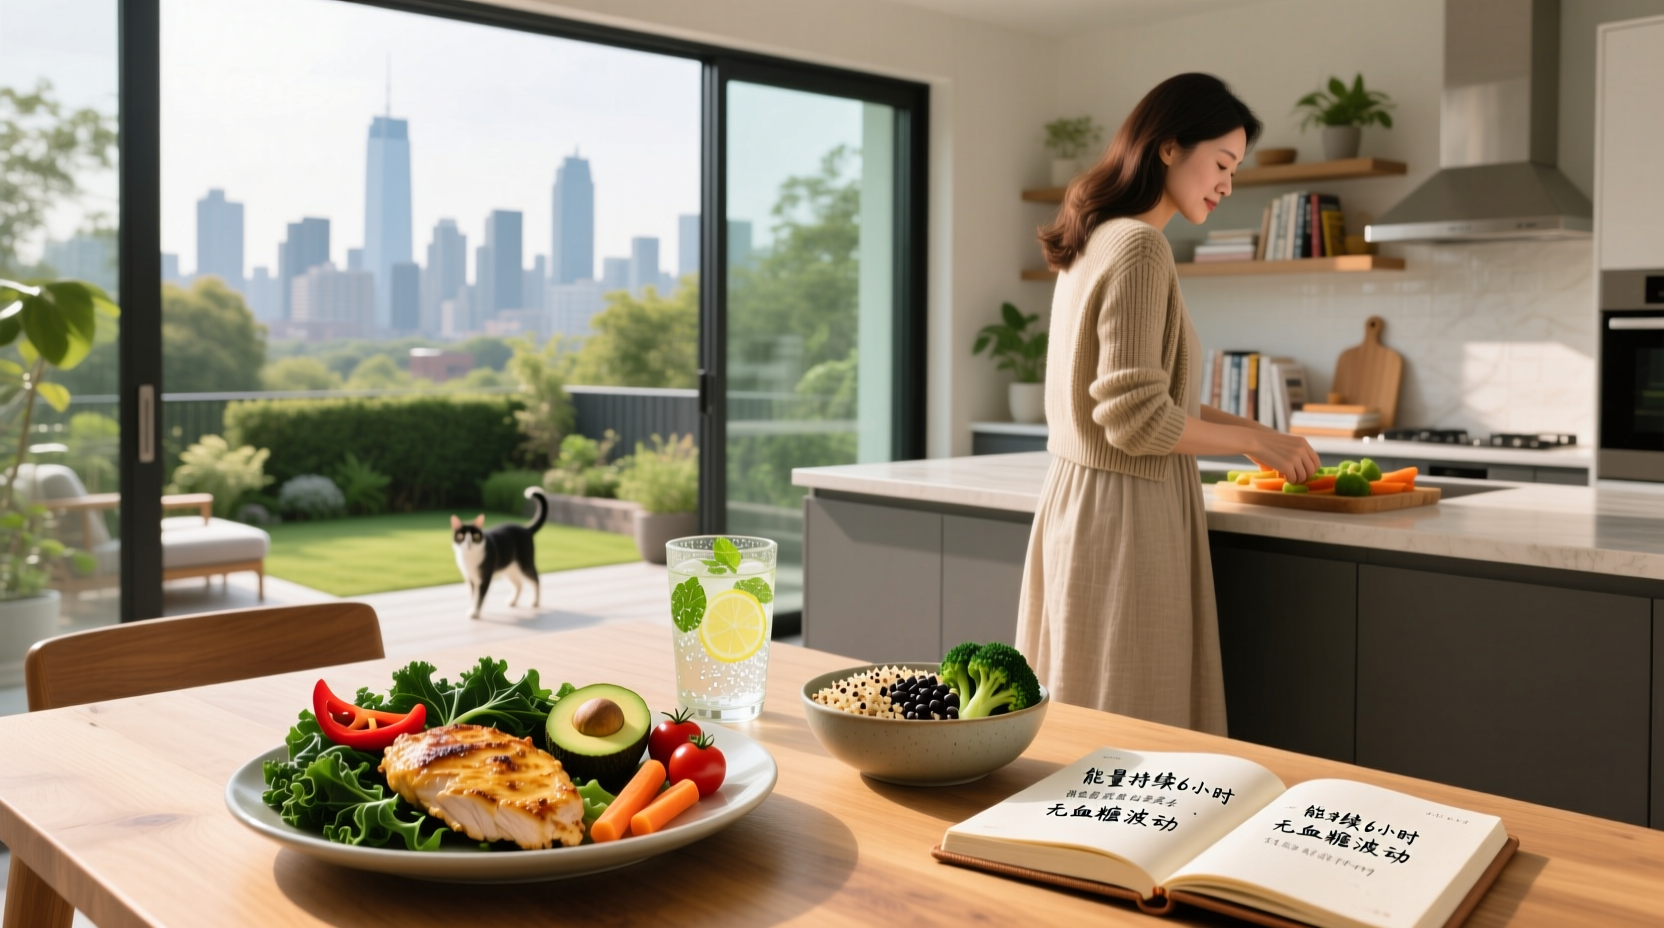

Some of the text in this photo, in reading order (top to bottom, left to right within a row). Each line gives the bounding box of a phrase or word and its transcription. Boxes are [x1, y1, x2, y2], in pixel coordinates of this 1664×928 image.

[1083, 767, 1236, 806] 能量持续6小时
[1046, 803, 1179, 832] 无血糖波动
[1273, 819, 1411, 864] 无血糖波动
